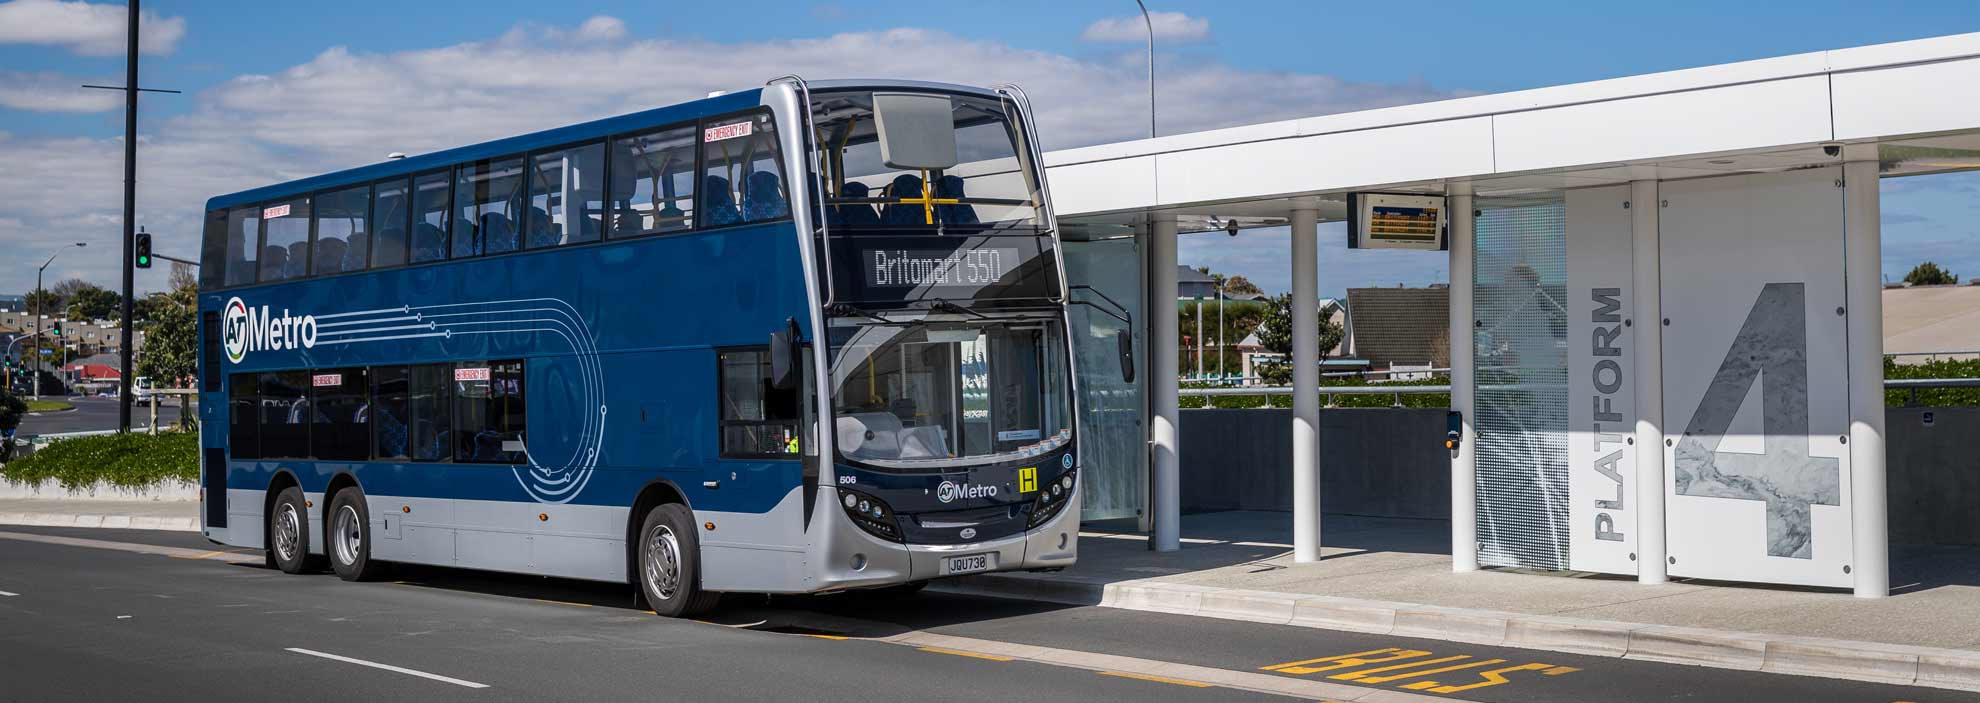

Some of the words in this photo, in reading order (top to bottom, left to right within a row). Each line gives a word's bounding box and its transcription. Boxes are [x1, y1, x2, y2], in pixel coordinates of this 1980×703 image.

[713, 125, 738, 140] EMERGENCY
[738, 123, 749, 136] EXIT
[875, 250, 962, 285] Britomart
[967, 249, 1001, 283] 550
[248, 305, 317, 352] Metro
[1591, 287, 1625, 543] PLATFORM
[1674, 282, 1841, 560] 4
[839, 475, 857, 485] 506
[955, 483, 997, 499] Metro
[1022, 468, 1035, 491] H
[1258, 647, 1584, 694] BUS
